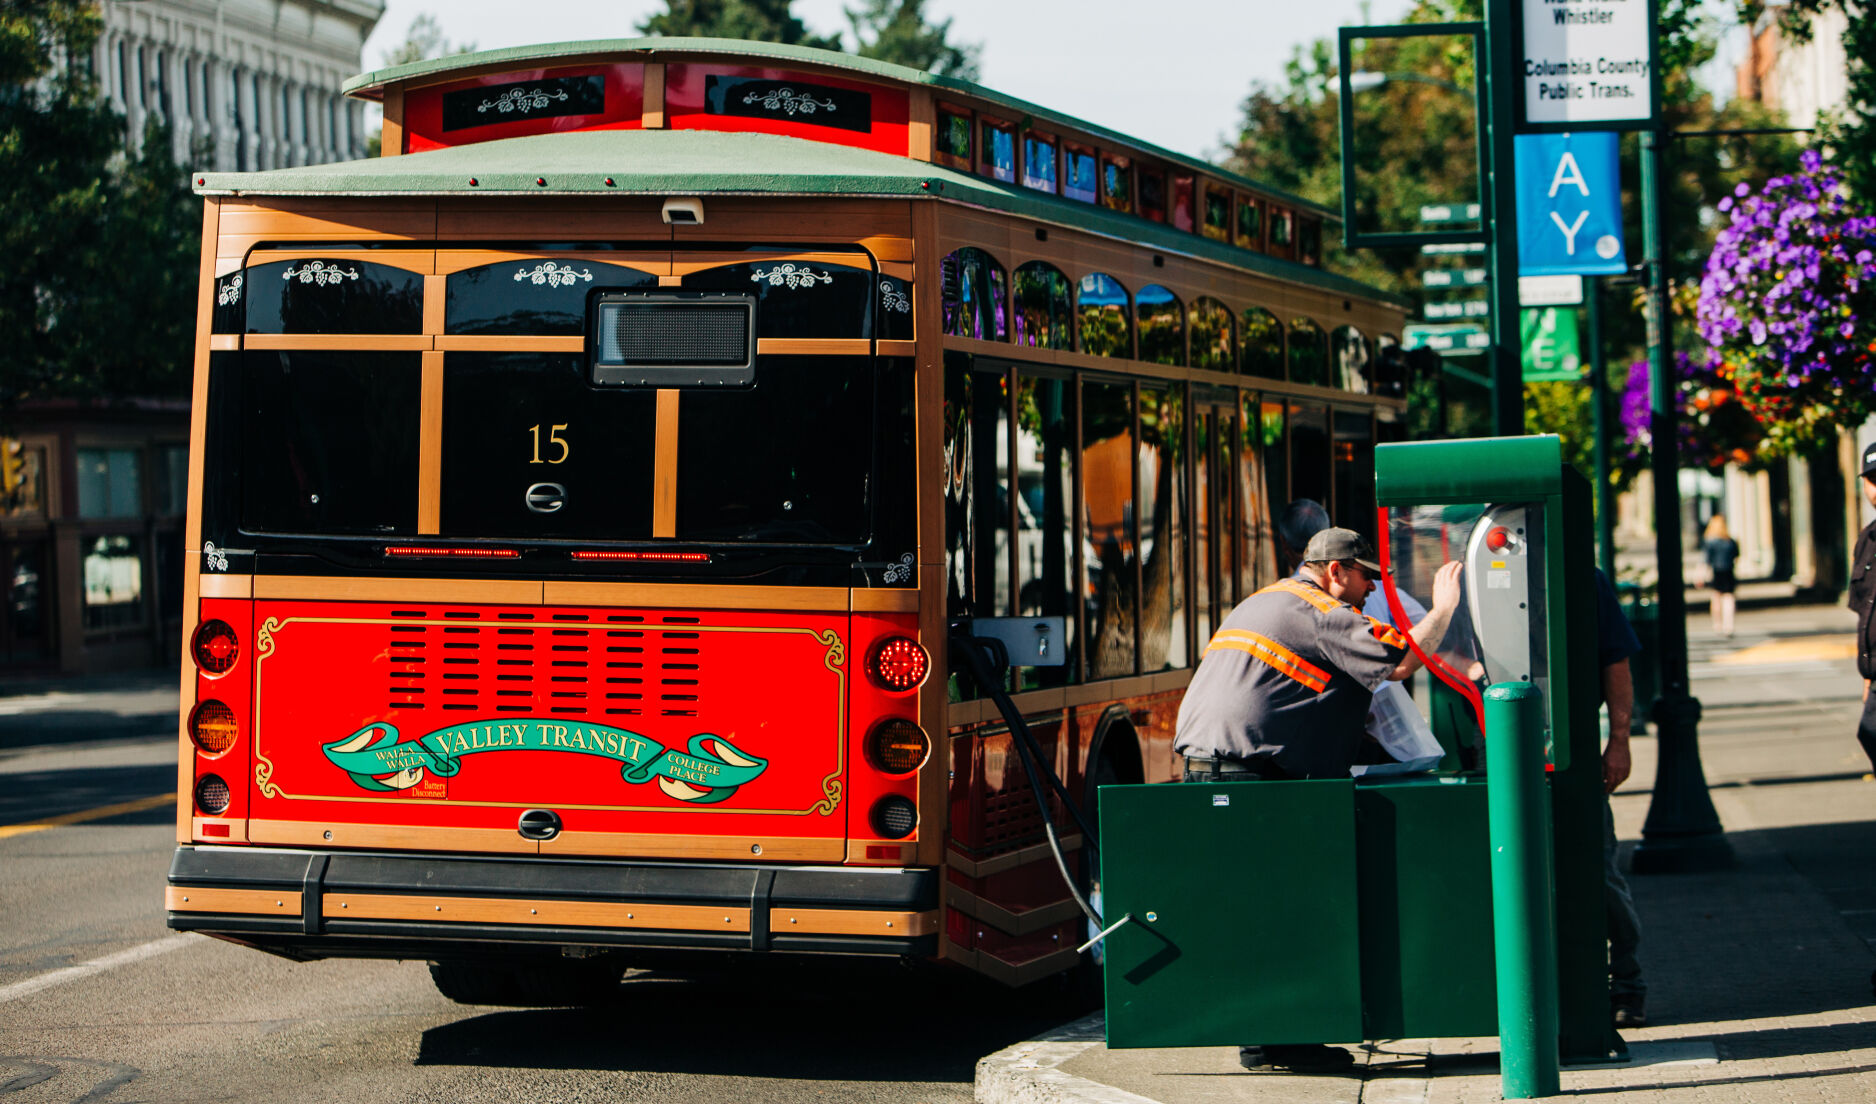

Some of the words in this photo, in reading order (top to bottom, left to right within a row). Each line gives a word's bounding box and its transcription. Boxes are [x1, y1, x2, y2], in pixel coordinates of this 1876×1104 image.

[1553, 8, 1613, 25] Whistler
[1524, 59, 1592, 77] Columbia
[1597, 58, 1650, 78] County
[1539, 82, 1583, 100] Public
[1589, 82, 1634, 98] Trans.
[1548, 132, 1590, 256] AY
[528, 422, 569, 464] 15
[435, 724, 528, 755] VALLEY
[536, 724, 647, 763] TRANSIT
[375, 746, 415, 761] WALLA
[386, 755, 426, 770] WALLA
[667, 753, 721, 776] COLLEGE
[669, 765, 707, 784] PLACE
[411, 787, 446, 798] Disconnect
[424, 780, 446, 791] Battery
